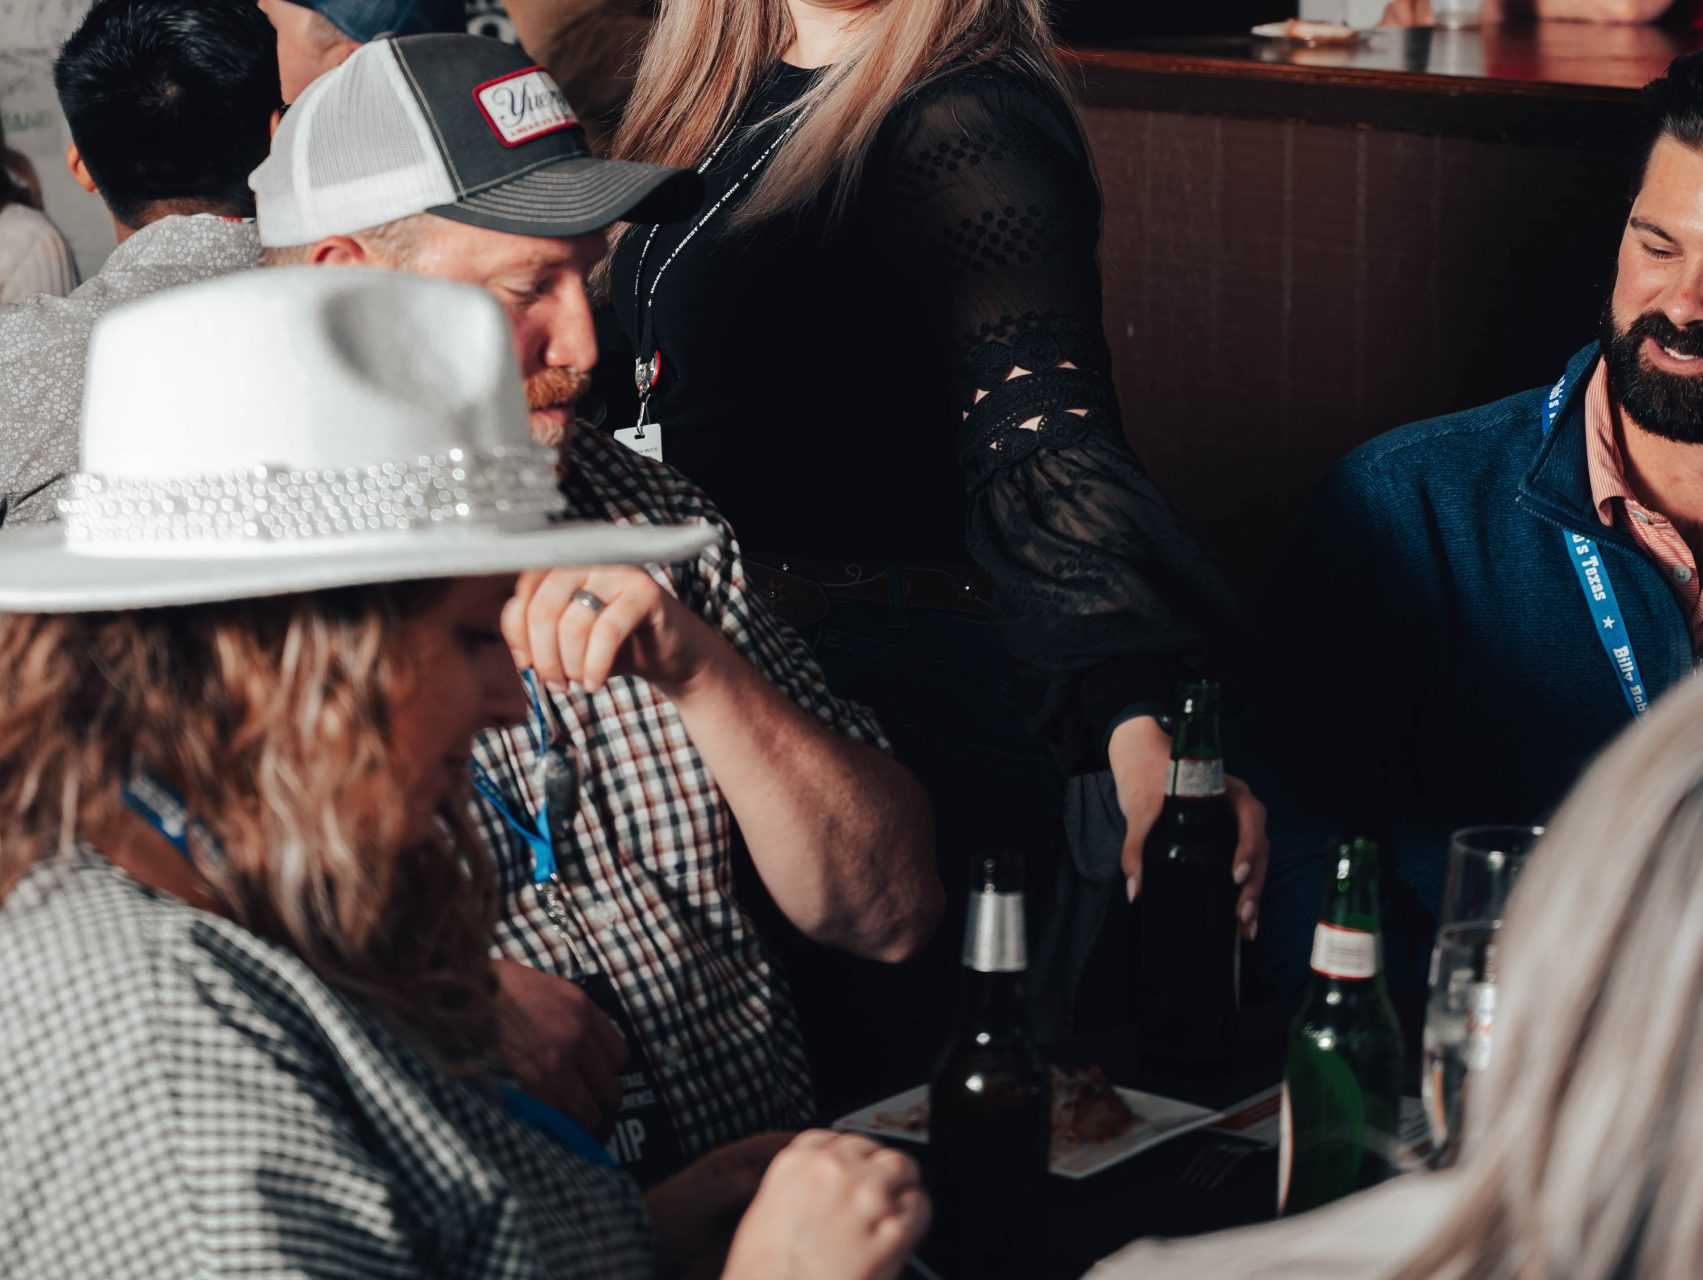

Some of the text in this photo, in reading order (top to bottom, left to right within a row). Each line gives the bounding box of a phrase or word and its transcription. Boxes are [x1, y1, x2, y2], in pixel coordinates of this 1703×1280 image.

[1581, 555, 1607, 602] Texas
[1612, 645, 1648, 713] Billy Bob
